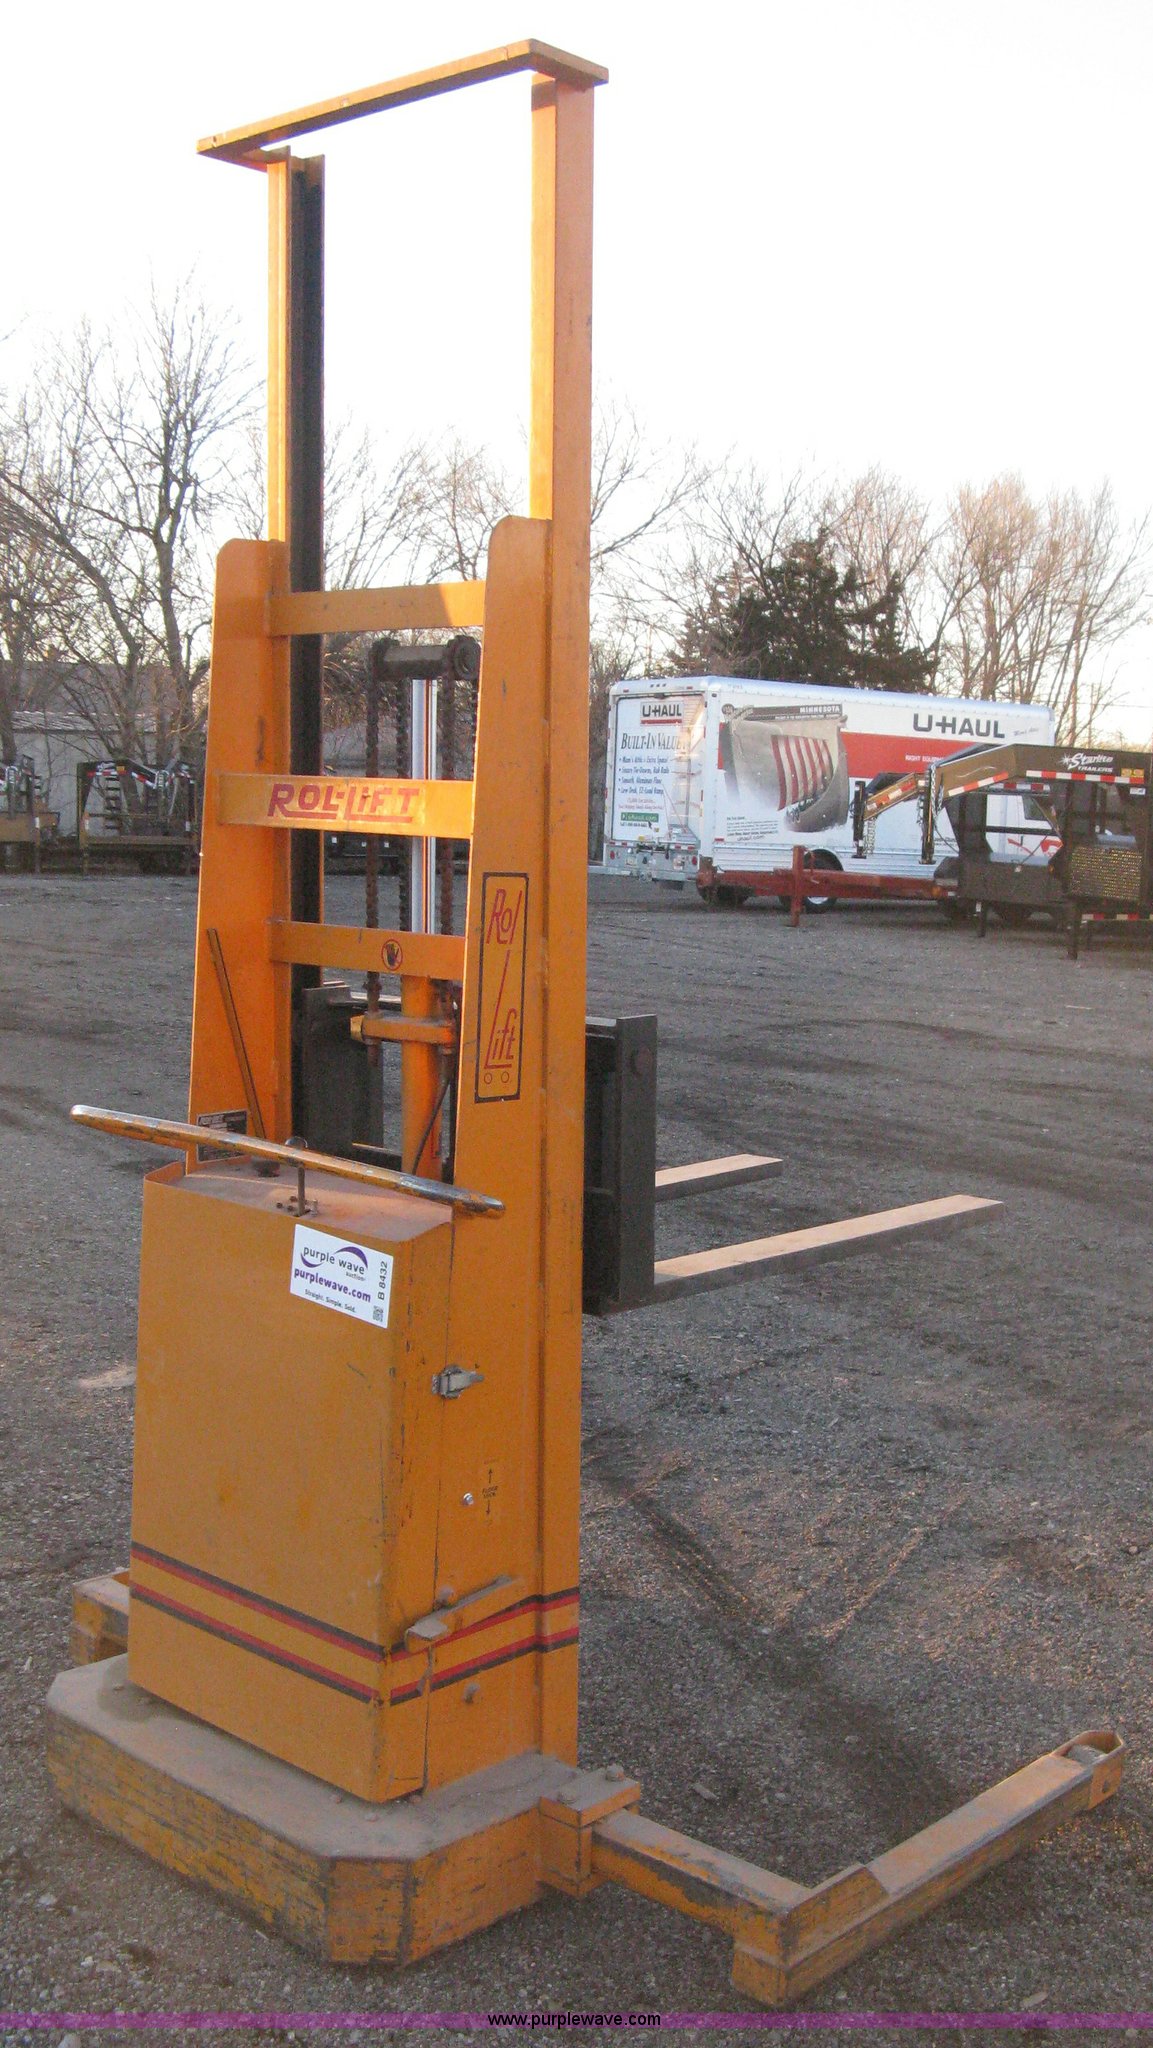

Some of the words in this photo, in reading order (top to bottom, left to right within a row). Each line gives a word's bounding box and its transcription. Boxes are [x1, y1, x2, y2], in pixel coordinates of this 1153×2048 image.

[642, 704, 682, 717] U-HAUL
[800, 705, 840, 713] MINNESOTA
[913, 713, 1005, 739] U-HAUL
[905, 754, 921, 762] RIGHT
[303, 1246, 335, 1265] purple
[338, 1258, 365, 1275] wave
[378, 1260, 388, 1289] 8432
[294, 1267, 371, 1303] purplewave.com
[377, 1291, 385, 1301] B
